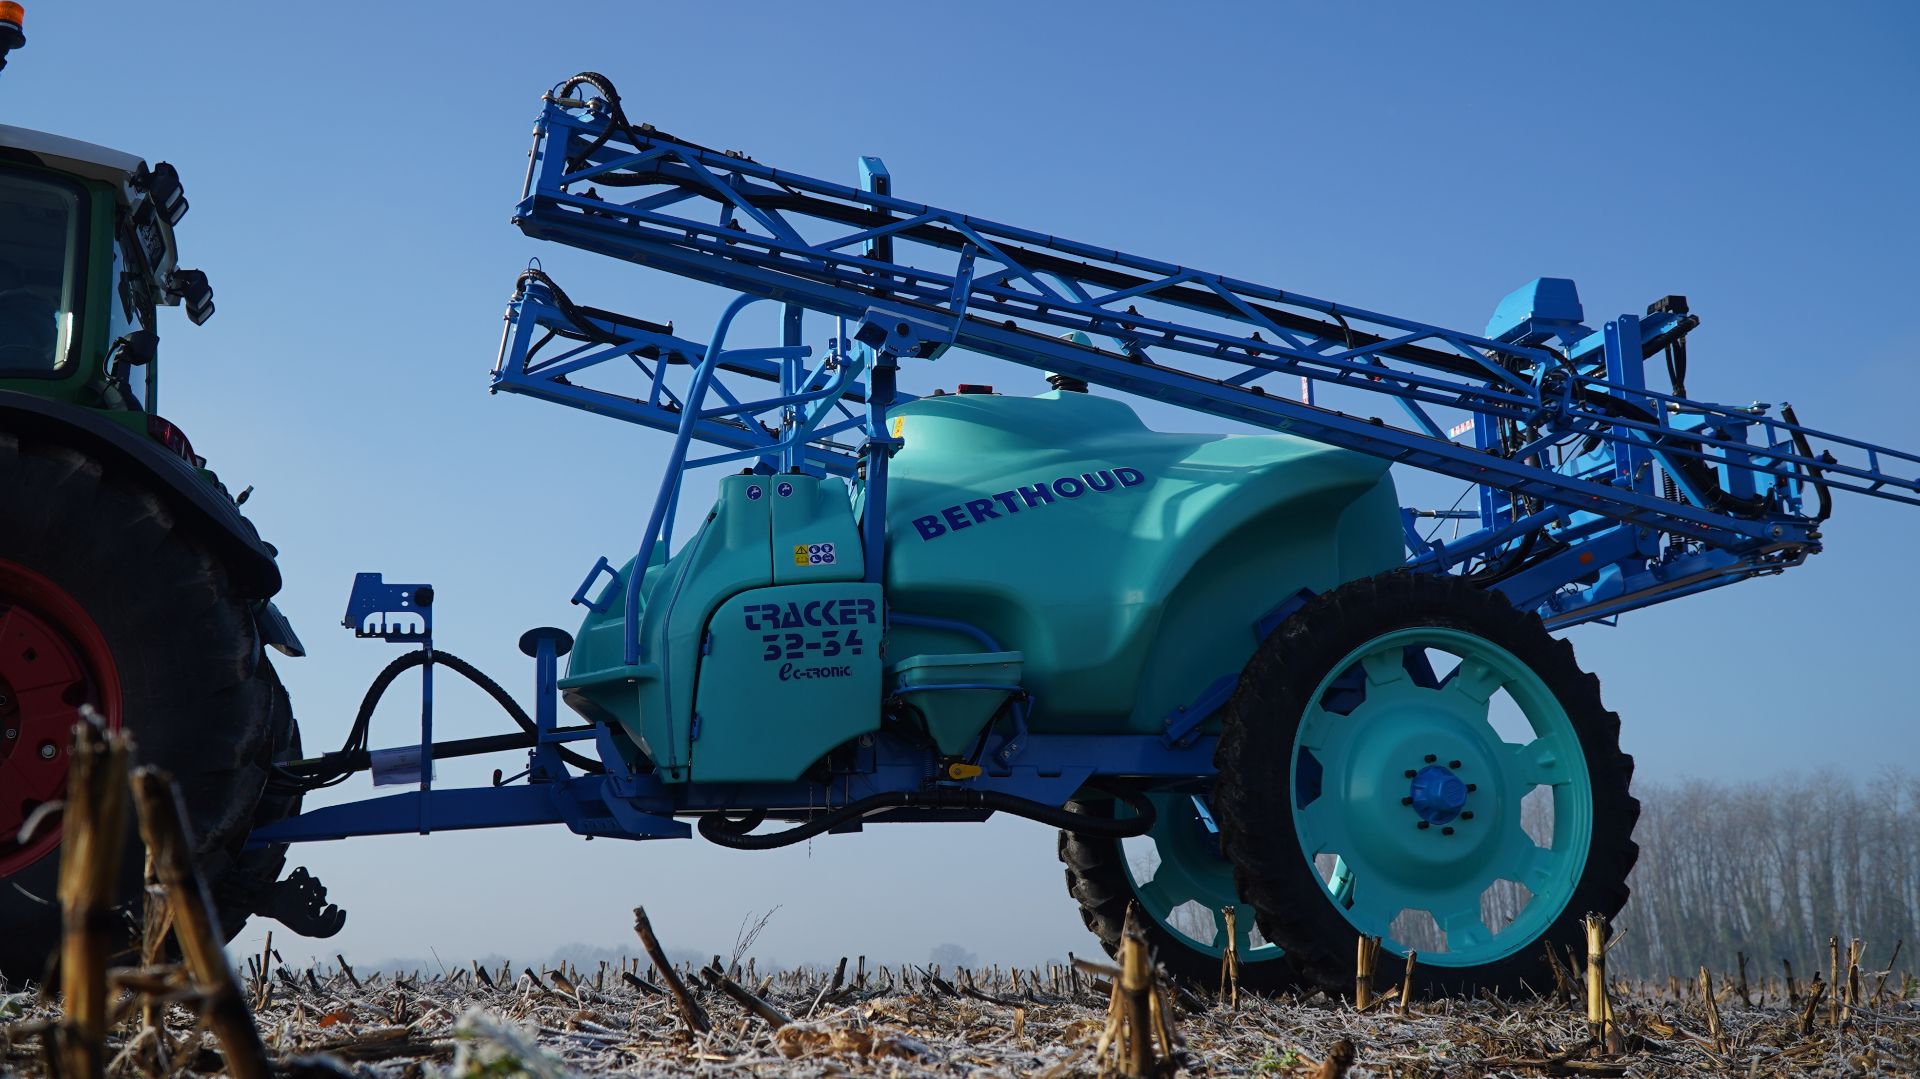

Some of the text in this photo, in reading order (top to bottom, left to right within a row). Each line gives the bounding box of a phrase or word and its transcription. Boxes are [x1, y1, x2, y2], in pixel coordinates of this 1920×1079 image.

[912, 467, 1145, 542] BERTHOUD
[744, 598, 877, 631] TRACKER
[763, 629, 863, 661] 32-34
